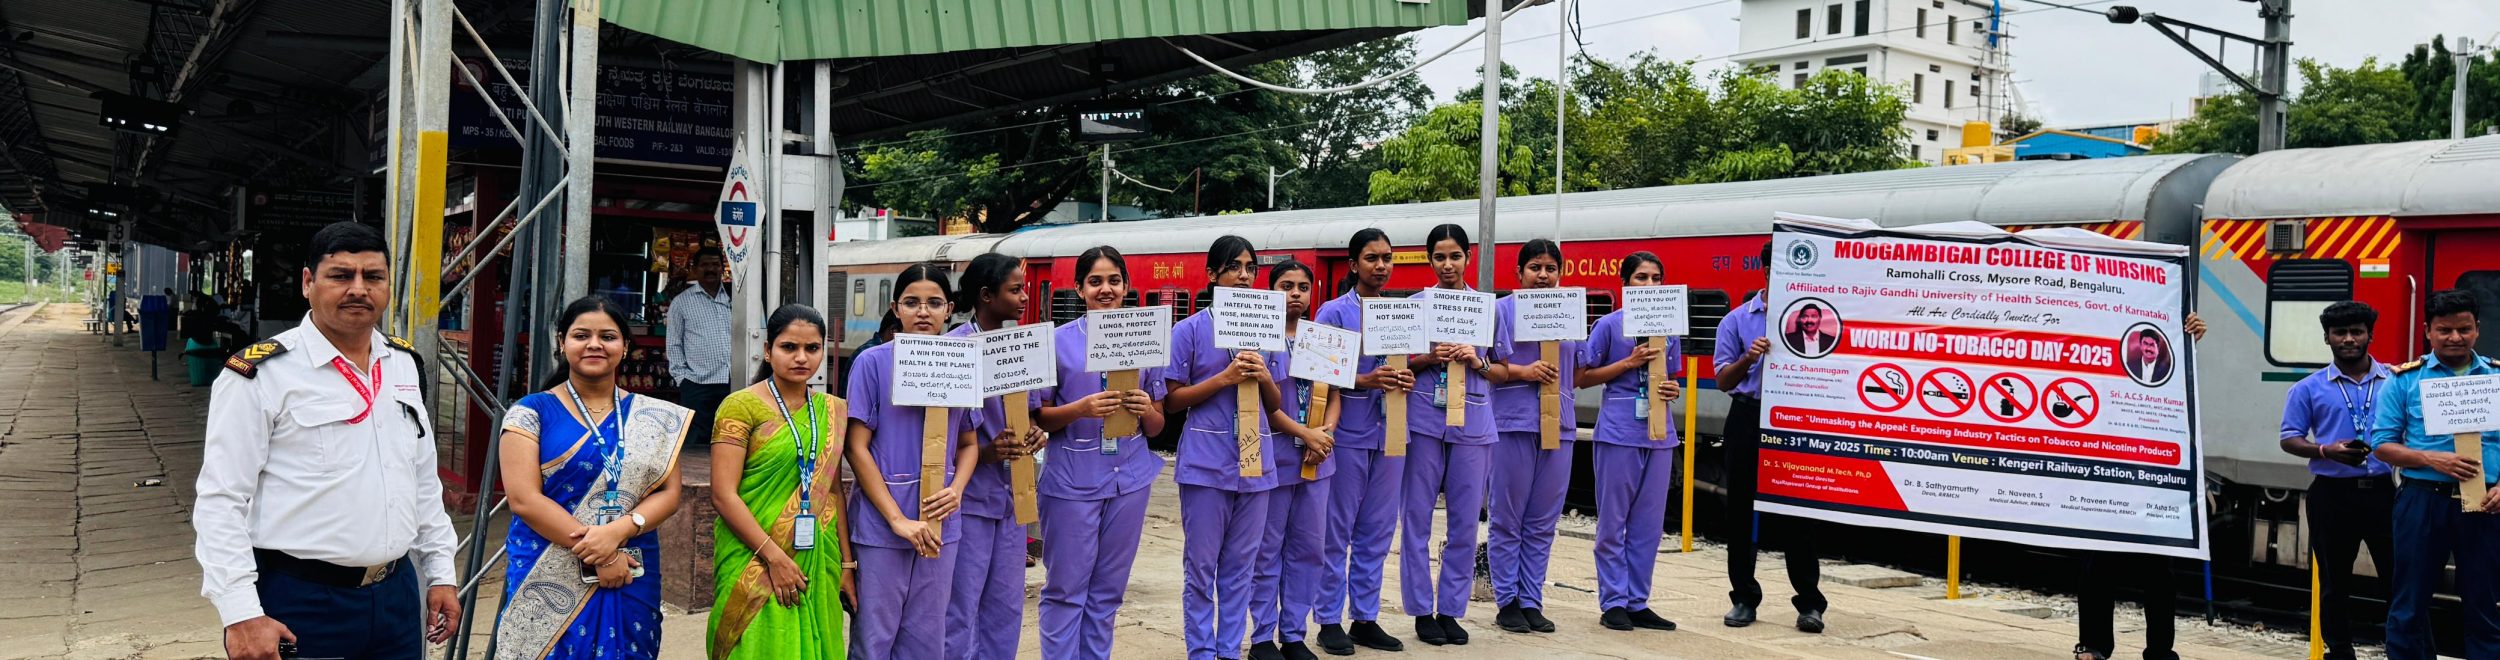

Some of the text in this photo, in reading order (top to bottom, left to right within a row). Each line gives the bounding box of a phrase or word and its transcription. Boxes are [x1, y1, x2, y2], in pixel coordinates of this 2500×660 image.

[463, 125, 480, 136] MPS
[485, 127, 495, 137] 35
[614, 117, 654, 131] WESTERN
[656, 120, 694, 136] RAILWAY
[608, 136, 635, 149] FOODS
[726, 243, 748, 263] KENGERI
[1834, 240, 2167, 285] MOOGAMBIGAI COLLEGE OF NURSING
[1886, 268, 2125, 295] Ramohalli Cross, Mysore Road, Bengaluru.
[1232, 292, 1262, 300] SMOKING
[1433, 292, 1484, 304] SMOKE FREE,
[1785, 282, 2170, 322] (Affiliated to Rajiv Gandhi University of Health Sciences, Govt. of Karnataka)
[1224, 301, 1252, 309] HATEFUL
[1432, 303, 1483, 314] STRESS FREE
[1102, 312, 1134, 320] PROTECT
[1240, 312, 1270, 320] HARMFUL
[1906, 305, 2062, 326] All Are Cordially Invited For
[1099, 320, 1157, 330] LUNGS, PROTECT
[986, 334, 1011, 343] DON'T
[1013, 331, 1025, 339] BE
[1218, 329, 1257, 338] DANGEROUS
[1009, 344, 1021, 352] TO
[1023, 341, 1040, 350] THE
[1850, 328, 2113, 368] WORLD NO-TOBACCO DAY-2025
[228, 357, 249, 372] SECURITY
[899, 359, 926, 367] HEALTH
[949, 361, 975, 369] PLANET
[996, 355, 1025, 366] CRAVE
[1769, 362, 1850, 376] Dr. A.C. Shanmugam
[2110, 390, 2123, 398] Sri.
[2124, 392, 2143, 400] A.C.S
[2144, 394, 2162, 403] Arun
[2163, 397, 2185, 407] Kumar
[1775, 412, 2177, 457] Theme: "Unmasking the Appeal: Exposing Industry Tactics on Tobacco and Nicotine Products"
[1760, 433, 2187, 486] Date 31st May 2025 Time 10:00am Venue Kengeri Railway Station, Bengaluru
[1763, 459, 1772, 467] Dr.
[1774, 460, 1780, 468] S.
[1782, 461, 1825, 474] Vijayanand
[1855, 470, 1872, 479] Ph.D
[1904, 479, 1980, 495] Dr. B. Sathyamurthy
[2080, 496, 2108, 506] Praveen
[2109, 499, 2130, 507] Kumar
